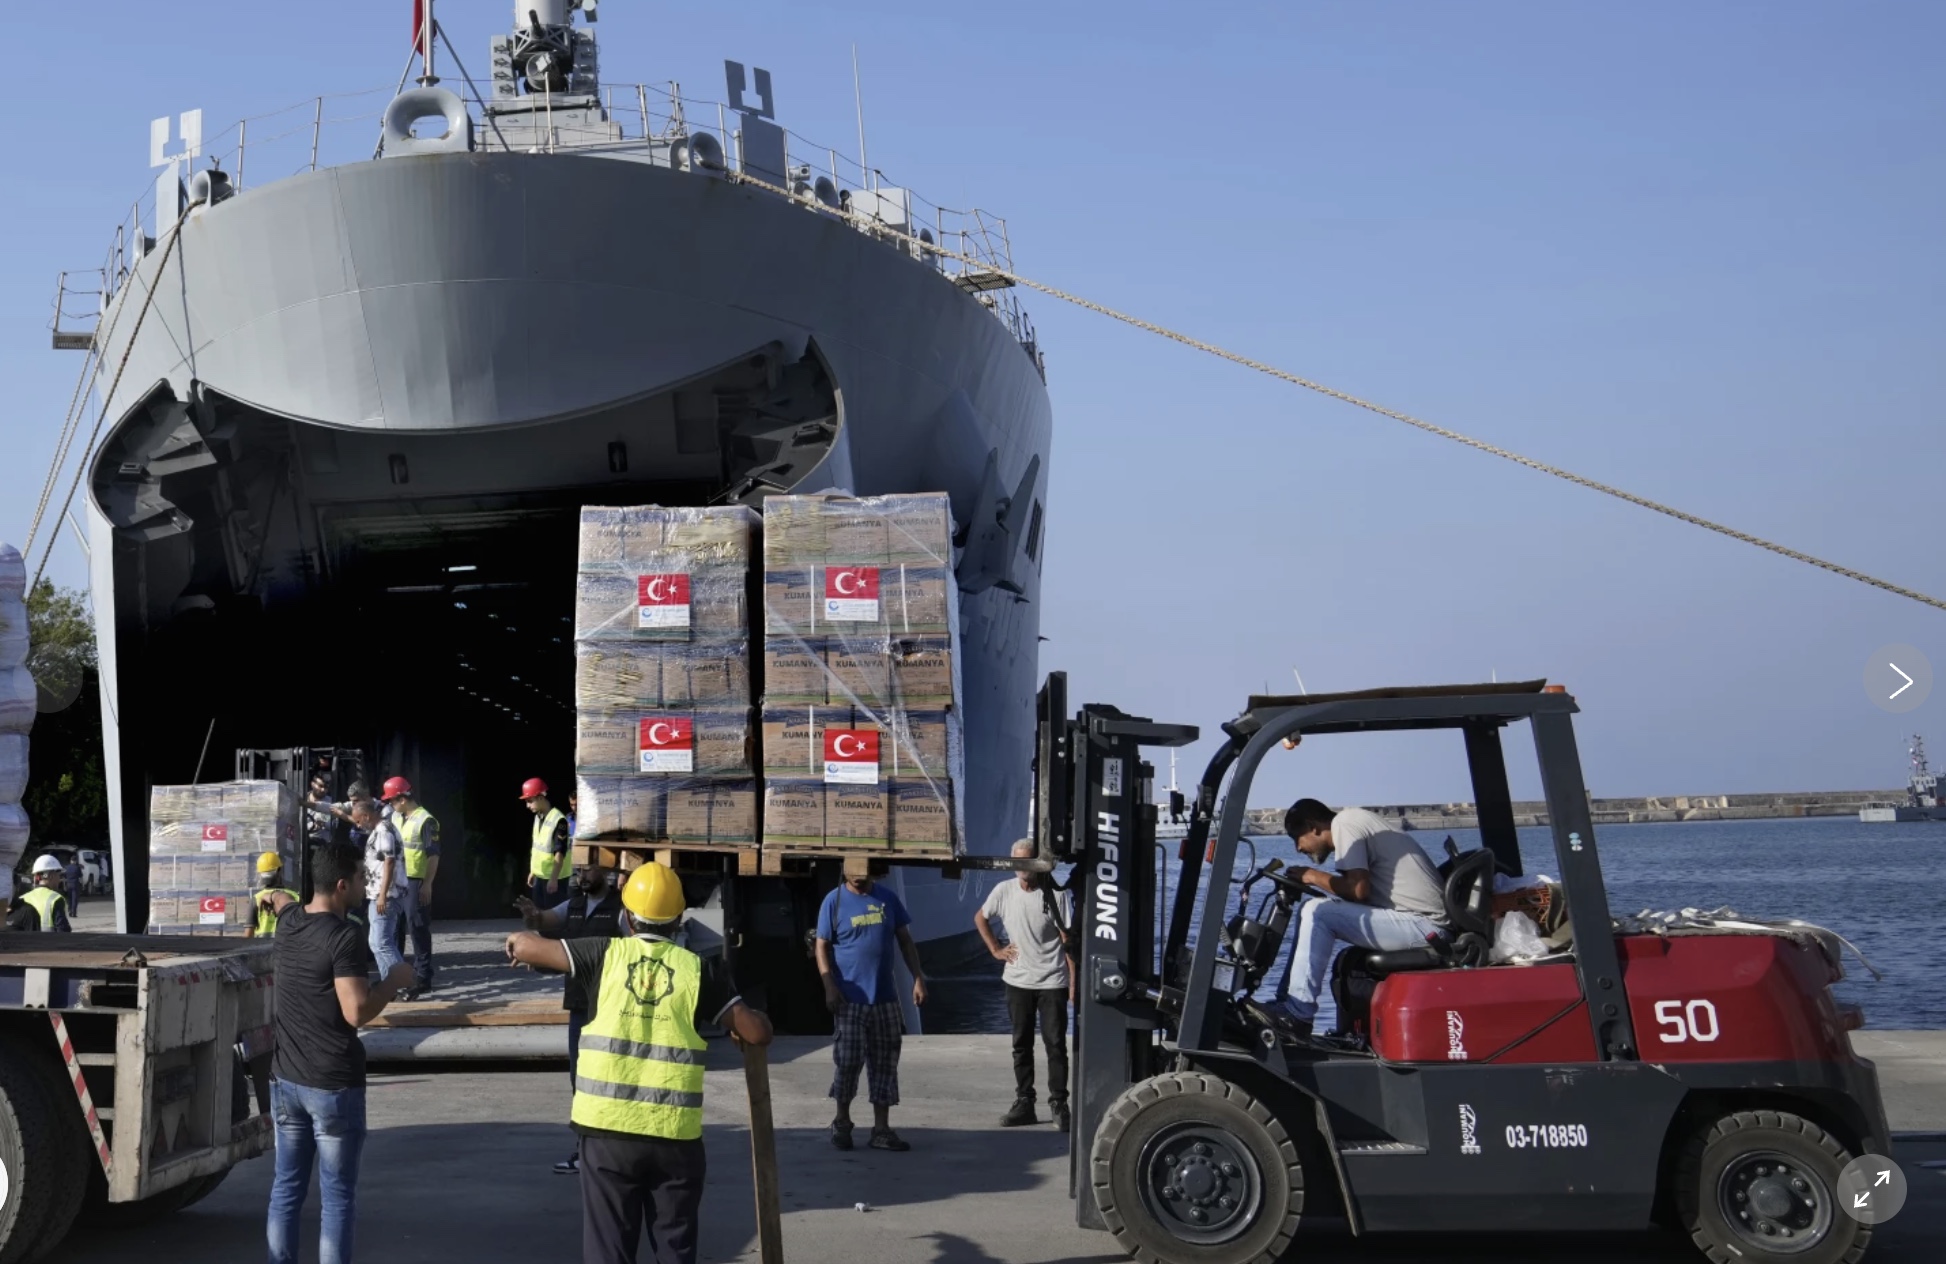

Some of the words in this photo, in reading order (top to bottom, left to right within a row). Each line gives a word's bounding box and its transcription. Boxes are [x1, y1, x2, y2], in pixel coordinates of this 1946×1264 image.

[836, 519, 882, 528] UMANYA
[784, 592, 825, 600] KUMANY
[835, 660, 884, 668] KUMANYA
[581, 731, 627, 739] KUMANYA
[700, 733, 743, 741] KUMANY
[782, 732, 824, 740] KUMANY
[597, 798, 639, 807] UMANYA
[688, 799, 735, 808] KUMNYA
[769, 799, 817, 809] KUMANYA
[834, 800, 883, 810] KUMANYA
[896, 804, 945, 814] KUMANYA
[1095, 811, 1119, 941] HIFOUNE
[1654, 999, 1720, 1043] 50
[1458, 1104, 1470, 1147] HOUMANI
[1505, 1124, 1588, 1148] 03-718850
